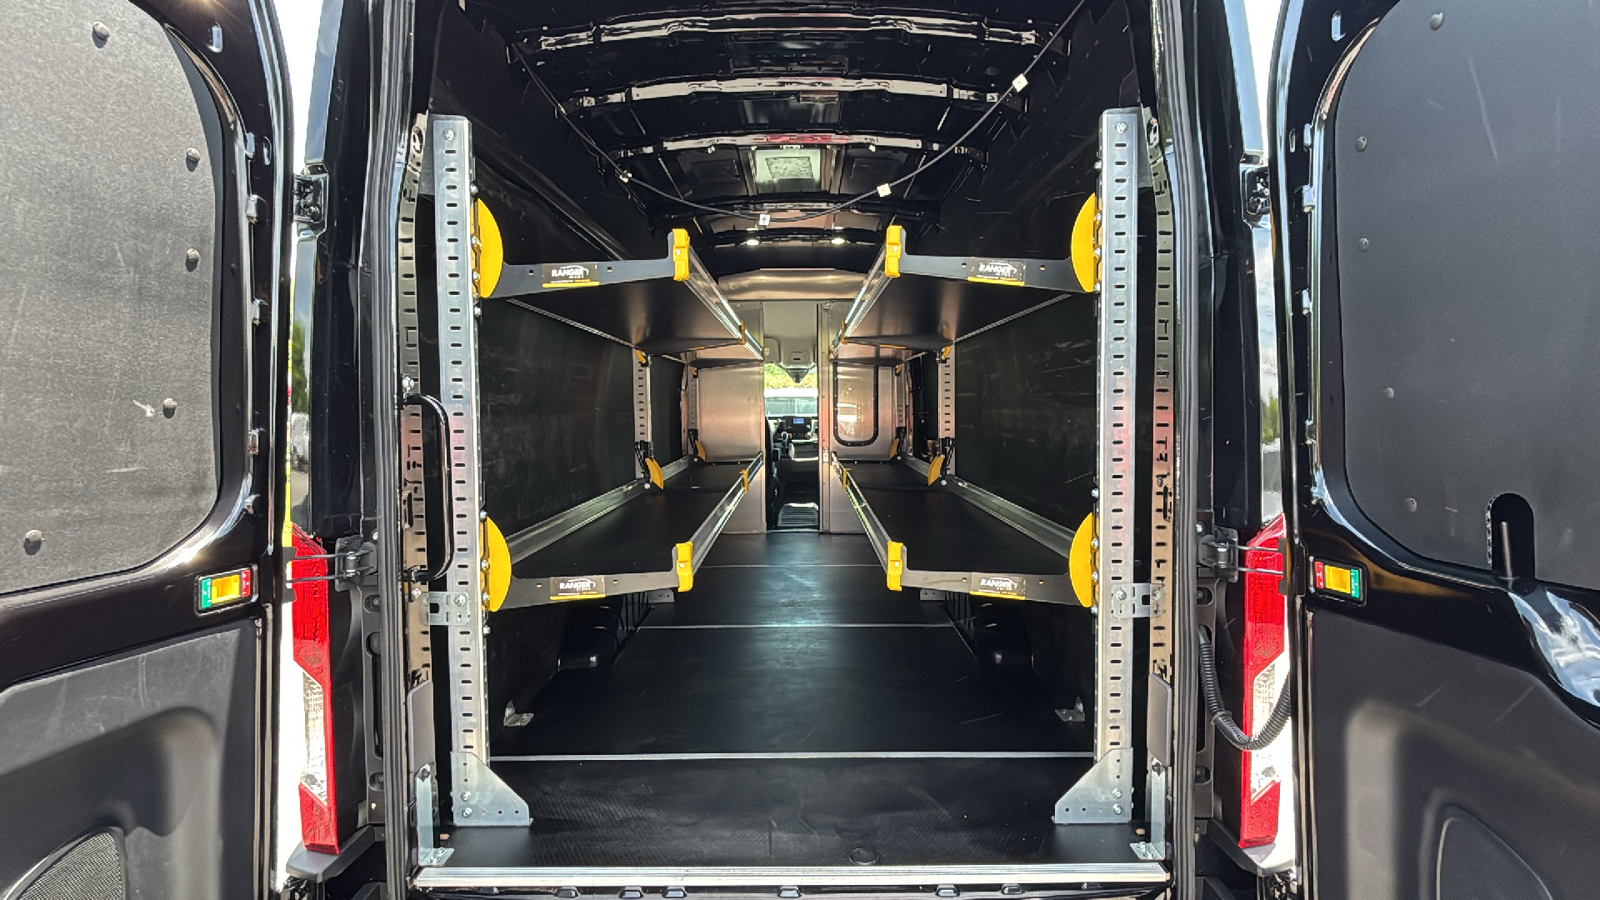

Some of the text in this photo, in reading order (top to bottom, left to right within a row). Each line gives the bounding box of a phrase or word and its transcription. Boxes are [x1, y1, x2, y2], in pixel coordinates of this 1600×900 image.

[551, 268, 584, 277] RANGER
[979, 263, 1010, 274] RANGER
[559, 581, 590, 589] RANGER
[980, 578, 1012, 587] RANGER
